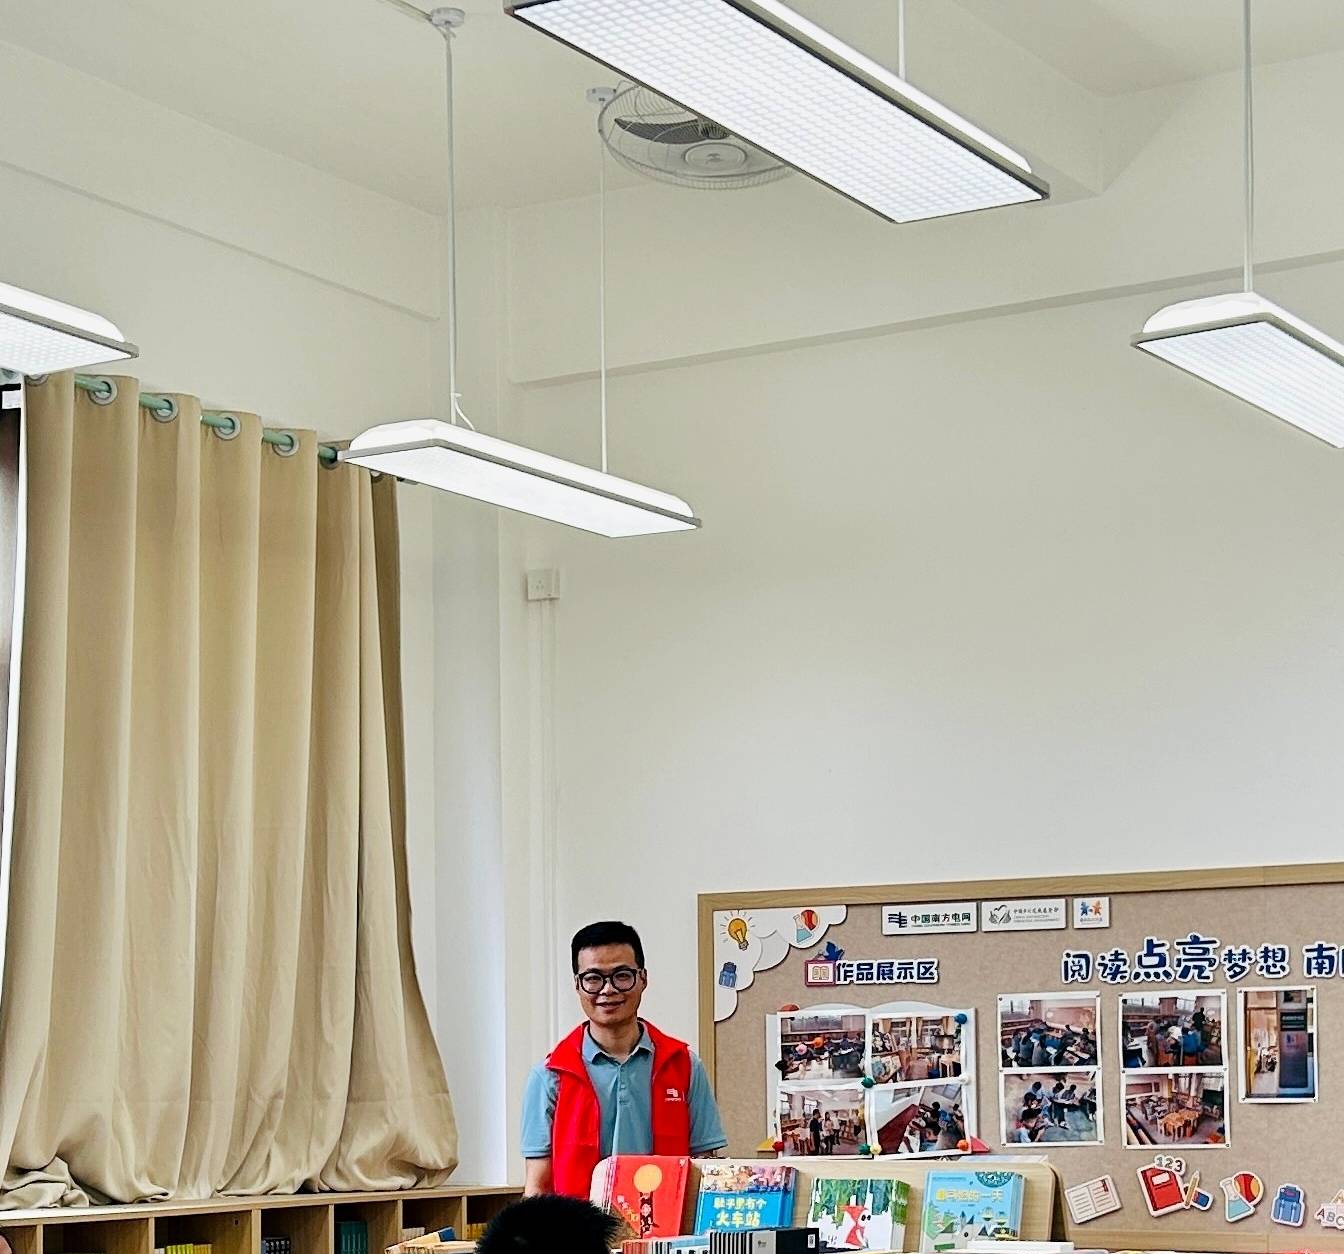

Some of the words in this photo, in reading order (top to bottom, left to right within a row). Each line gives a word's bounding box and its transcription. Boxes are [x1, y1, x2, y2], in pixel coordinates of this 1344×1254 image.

[911, 913, 971, 924] 中国南方电网
[1062, 935, 1289, 982] 阅读点亮梦想
[836, 961, 938, 982] 作品展示区
[1156, 1157, 1183, 1172] 123
[716, 1209, 761, 1228] 火车站
